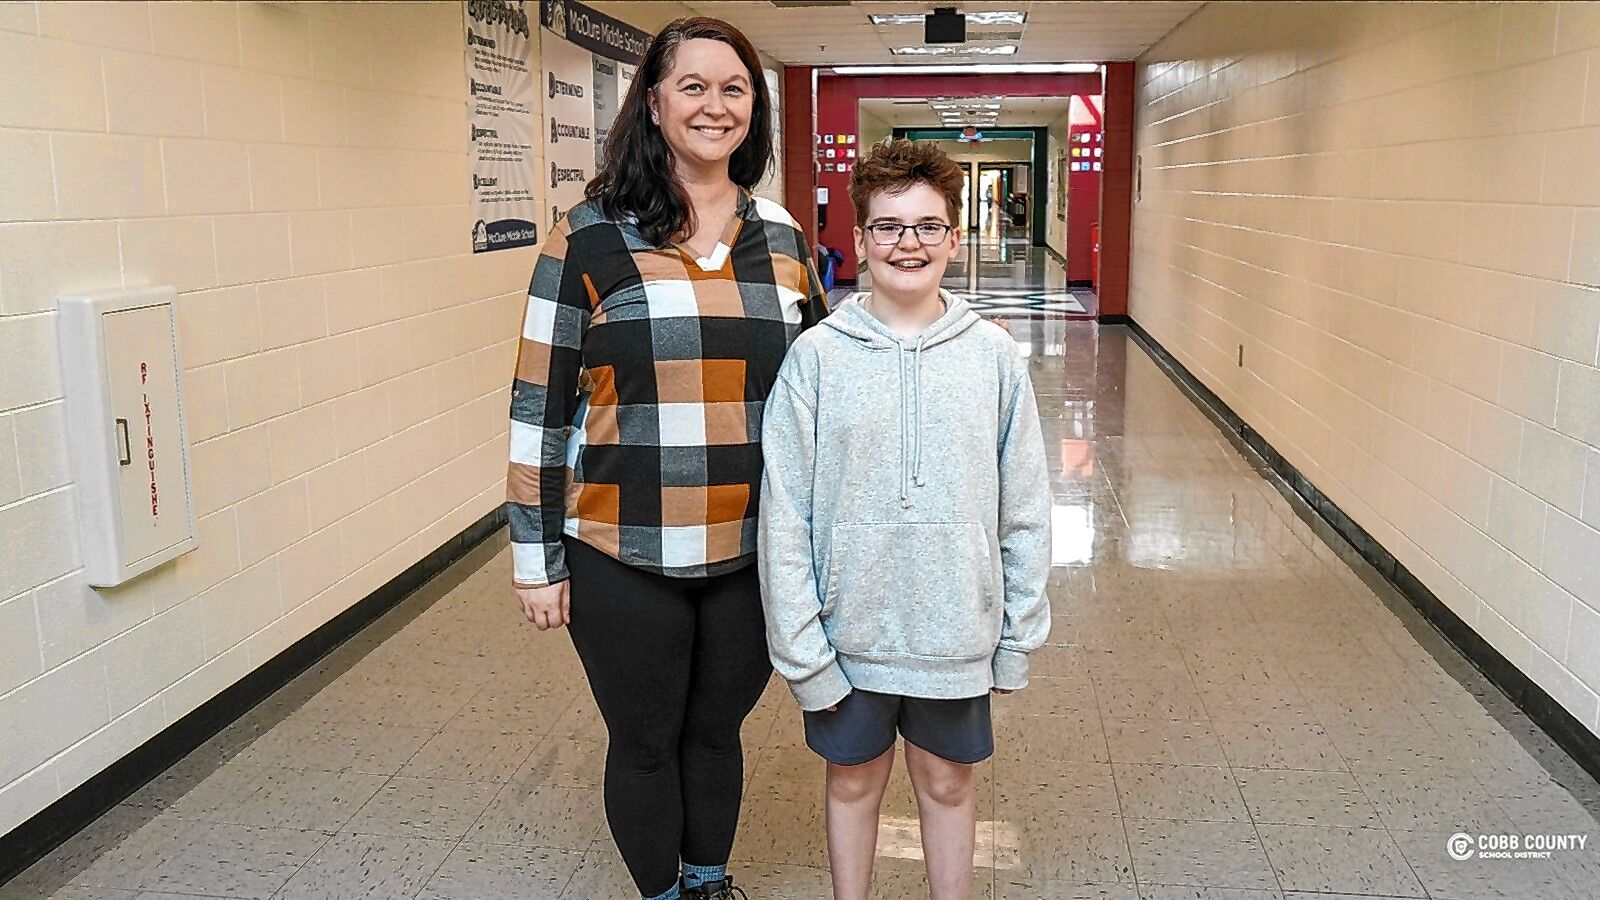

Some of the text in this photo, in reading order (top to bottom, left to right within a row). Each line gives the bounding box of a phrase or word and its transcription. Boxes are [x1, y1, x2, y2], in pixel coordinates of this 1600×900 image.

[569, 9, 646, 57] McClure Middle School
[549, 72, 583, 99] DETERMINED
[551, 117, 590, 143] ACCOUNTABLE
[551, 162, 585, 188] RESPECTFUL
